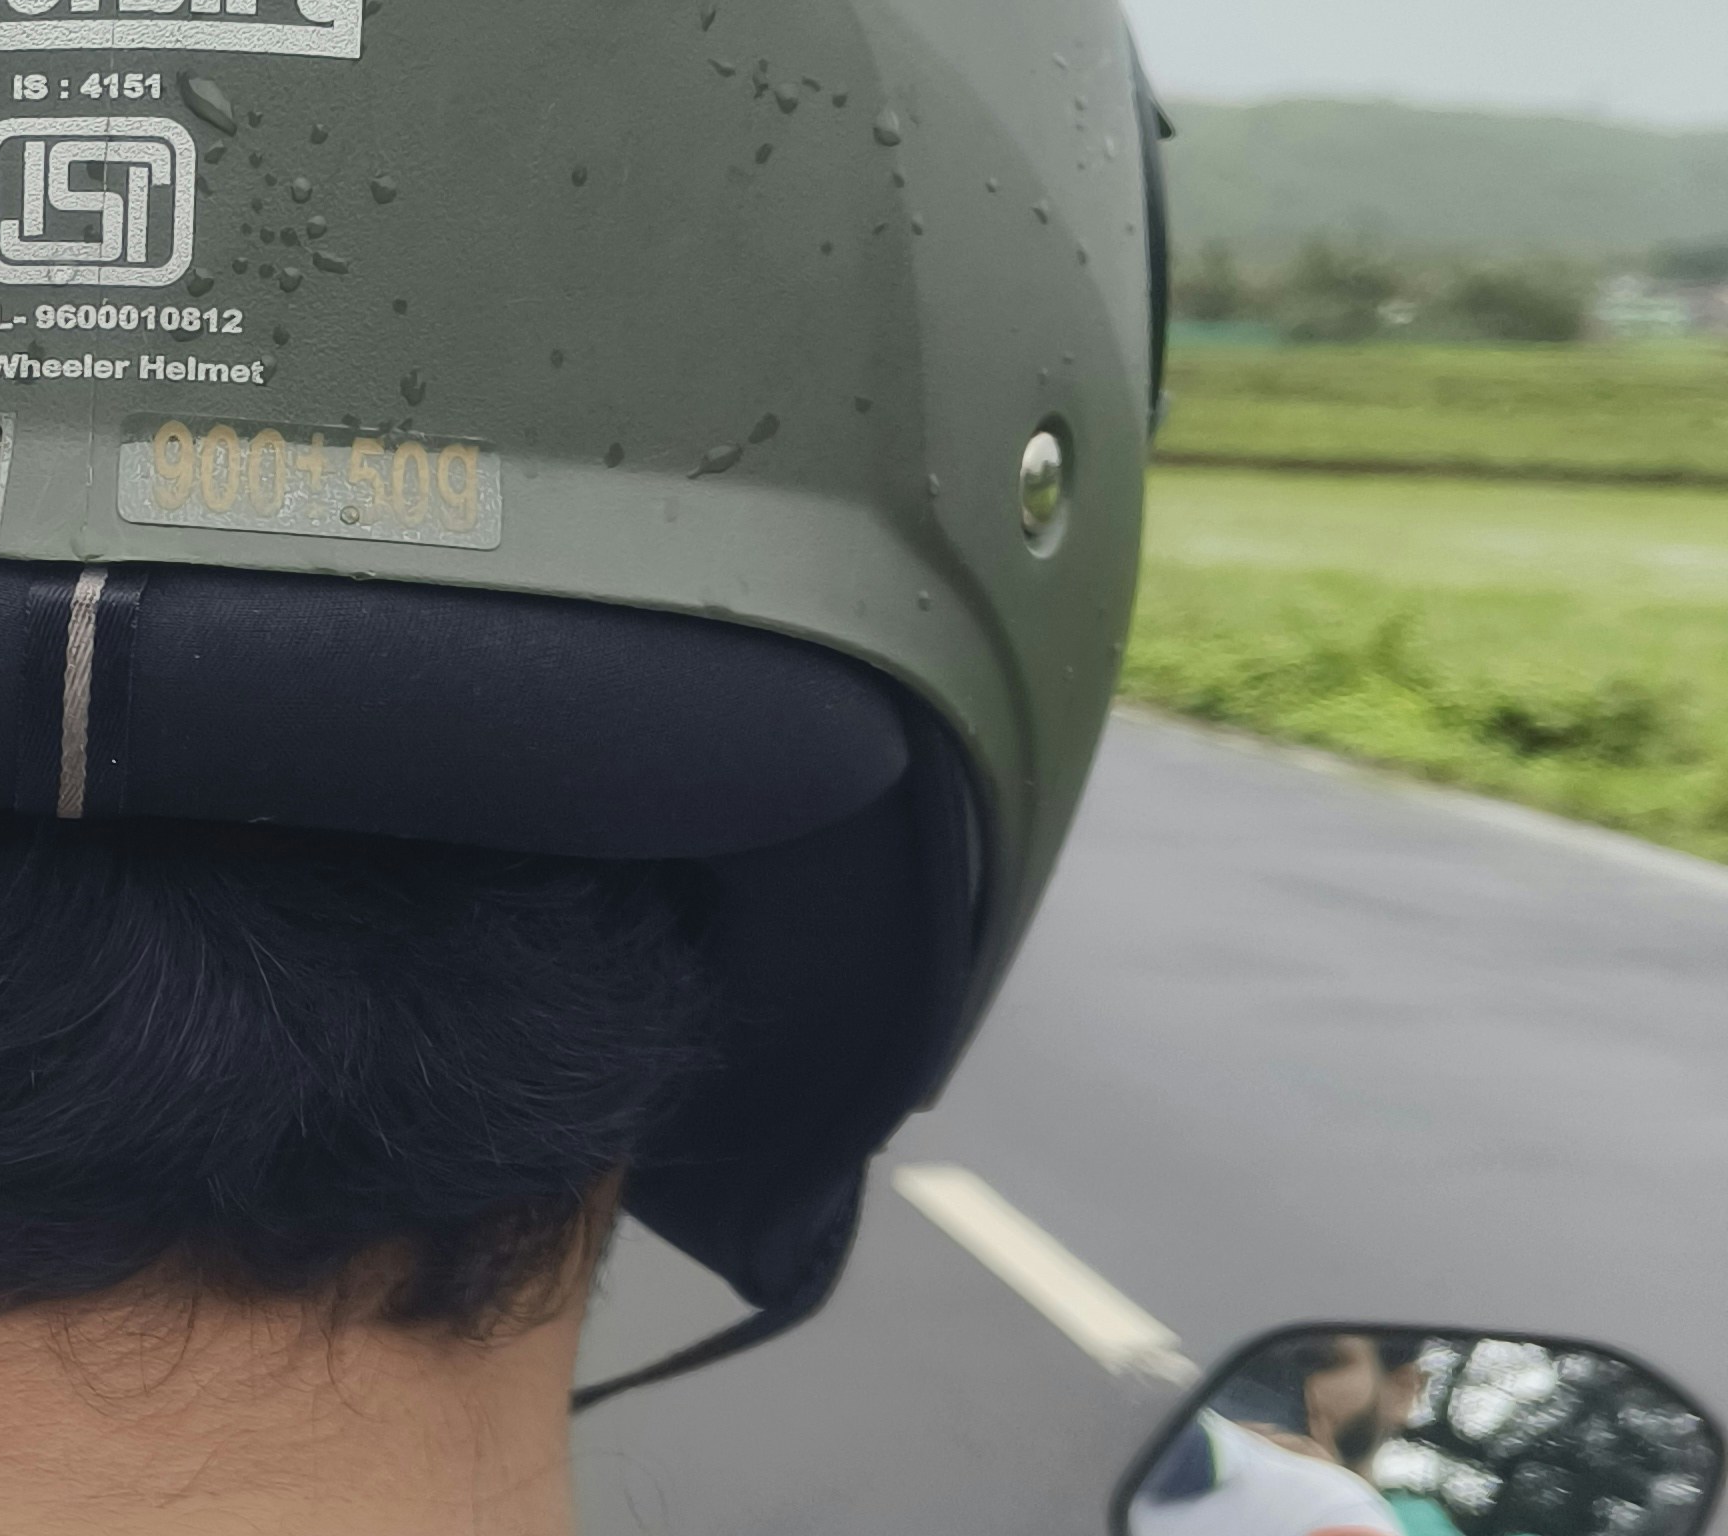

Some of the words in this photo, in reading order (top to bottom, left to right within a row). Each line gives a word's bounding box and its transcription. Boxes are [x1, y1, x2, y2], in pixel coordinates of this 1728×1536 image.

[12, 73, 48, 100] IS
[80, 72, 162, 100] 4151
[35, 305, 244, 334] 9600010812
[138, 355, 266, 385] Helmet
